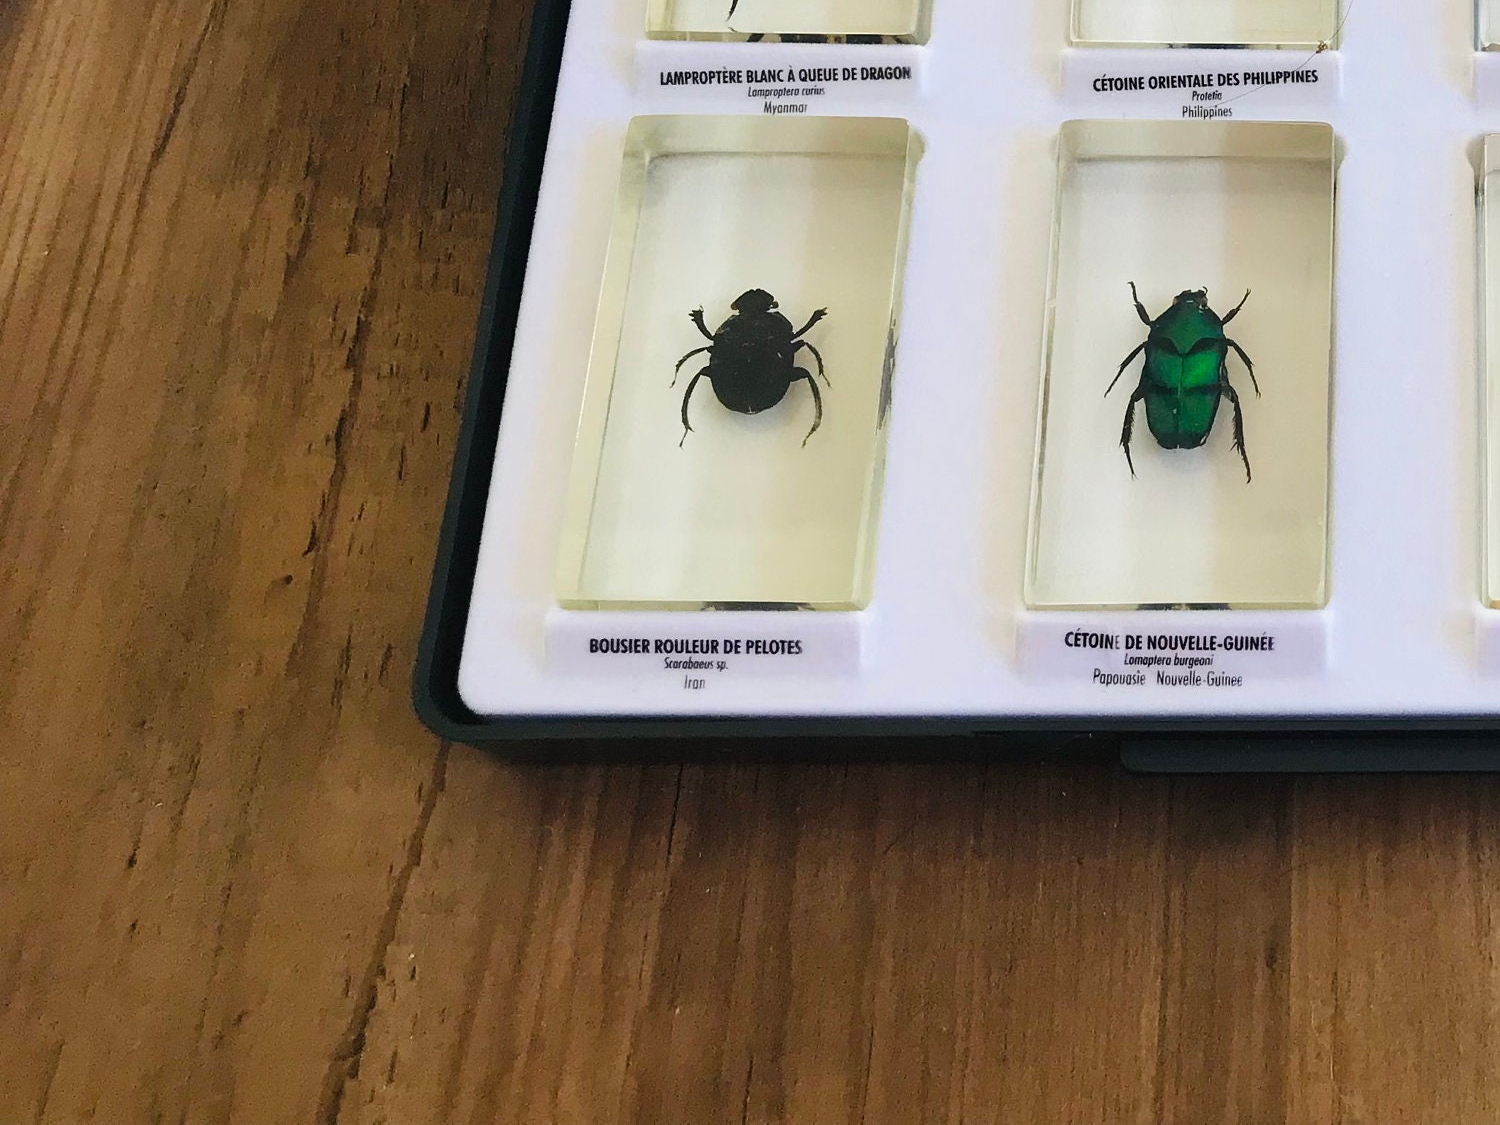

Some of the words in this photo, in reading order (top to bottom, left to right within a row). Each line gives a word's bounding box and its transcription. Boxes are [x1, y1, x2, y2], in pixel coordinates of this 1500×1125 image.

[660, 67, 743, 85] LAMPROPTÈRE
[746, 70, 785, 83] BLANC
[788, 65, 795, 82] À
[798, 68, 839, 82] QUEUE
[842, 67, 857, 80] DE
[861, 66, 911, 80] DRAGON
[1093, 74, 1144, 91] CÉTOINE
[1150, 74, 1214, 89] ORIENTALE
[1218, 73, 1240, 86] DES
[1244, 70, 1318, 85] PHILIPPINES
[748, 86, 799, 98] Lamproptera
[764, 101, 808, 115] Myanmar
[1182, 106, 1232, 120] Philippines
[589, 638, 650, 654] BOUSIER
[655, 639, 719, 654] ROULEUR
[723, 639, 742, 654] DE
[746, 640, 803, 655] PELOTES
[1125, 635, 1143, 650] DE
[1147, 632, 1275, 651] NOUVELLE-GUINÉE
[664, 657, 714, 669] Scarabaeus
[1124, 653, 1171, 667] Lomaptera
[1174, 654, 1213, 669] burgeoni
[684, 675, 705, 690] Iran
[1093, 669, 1146, 686] Papouasie
